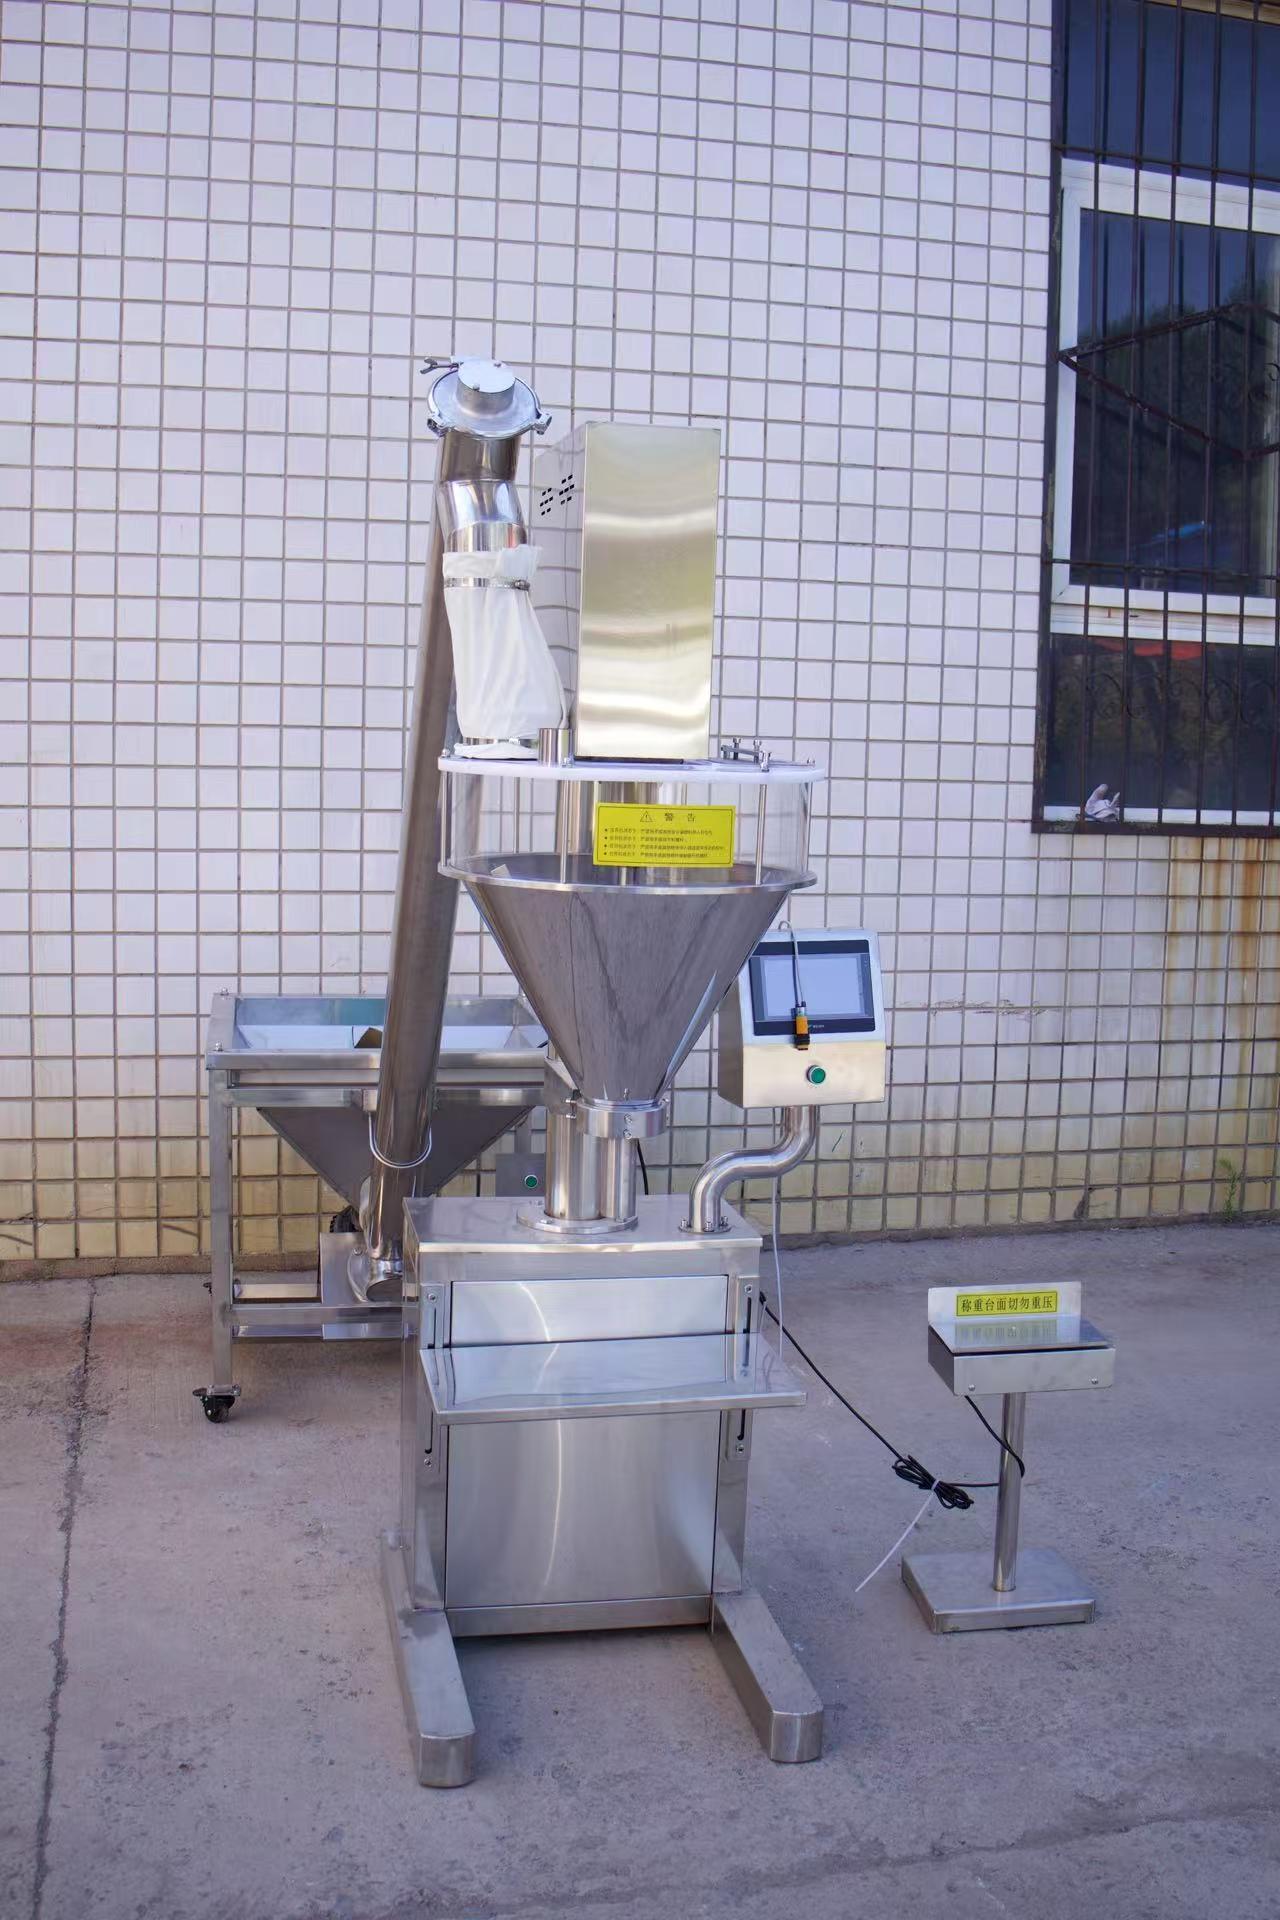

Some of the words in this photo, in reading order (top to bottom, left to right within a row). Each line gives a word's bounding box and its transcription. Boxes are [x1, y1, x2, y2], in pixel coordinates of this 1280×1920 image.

[961, 1296, 1053, 1312] 称重台面切勿重压
